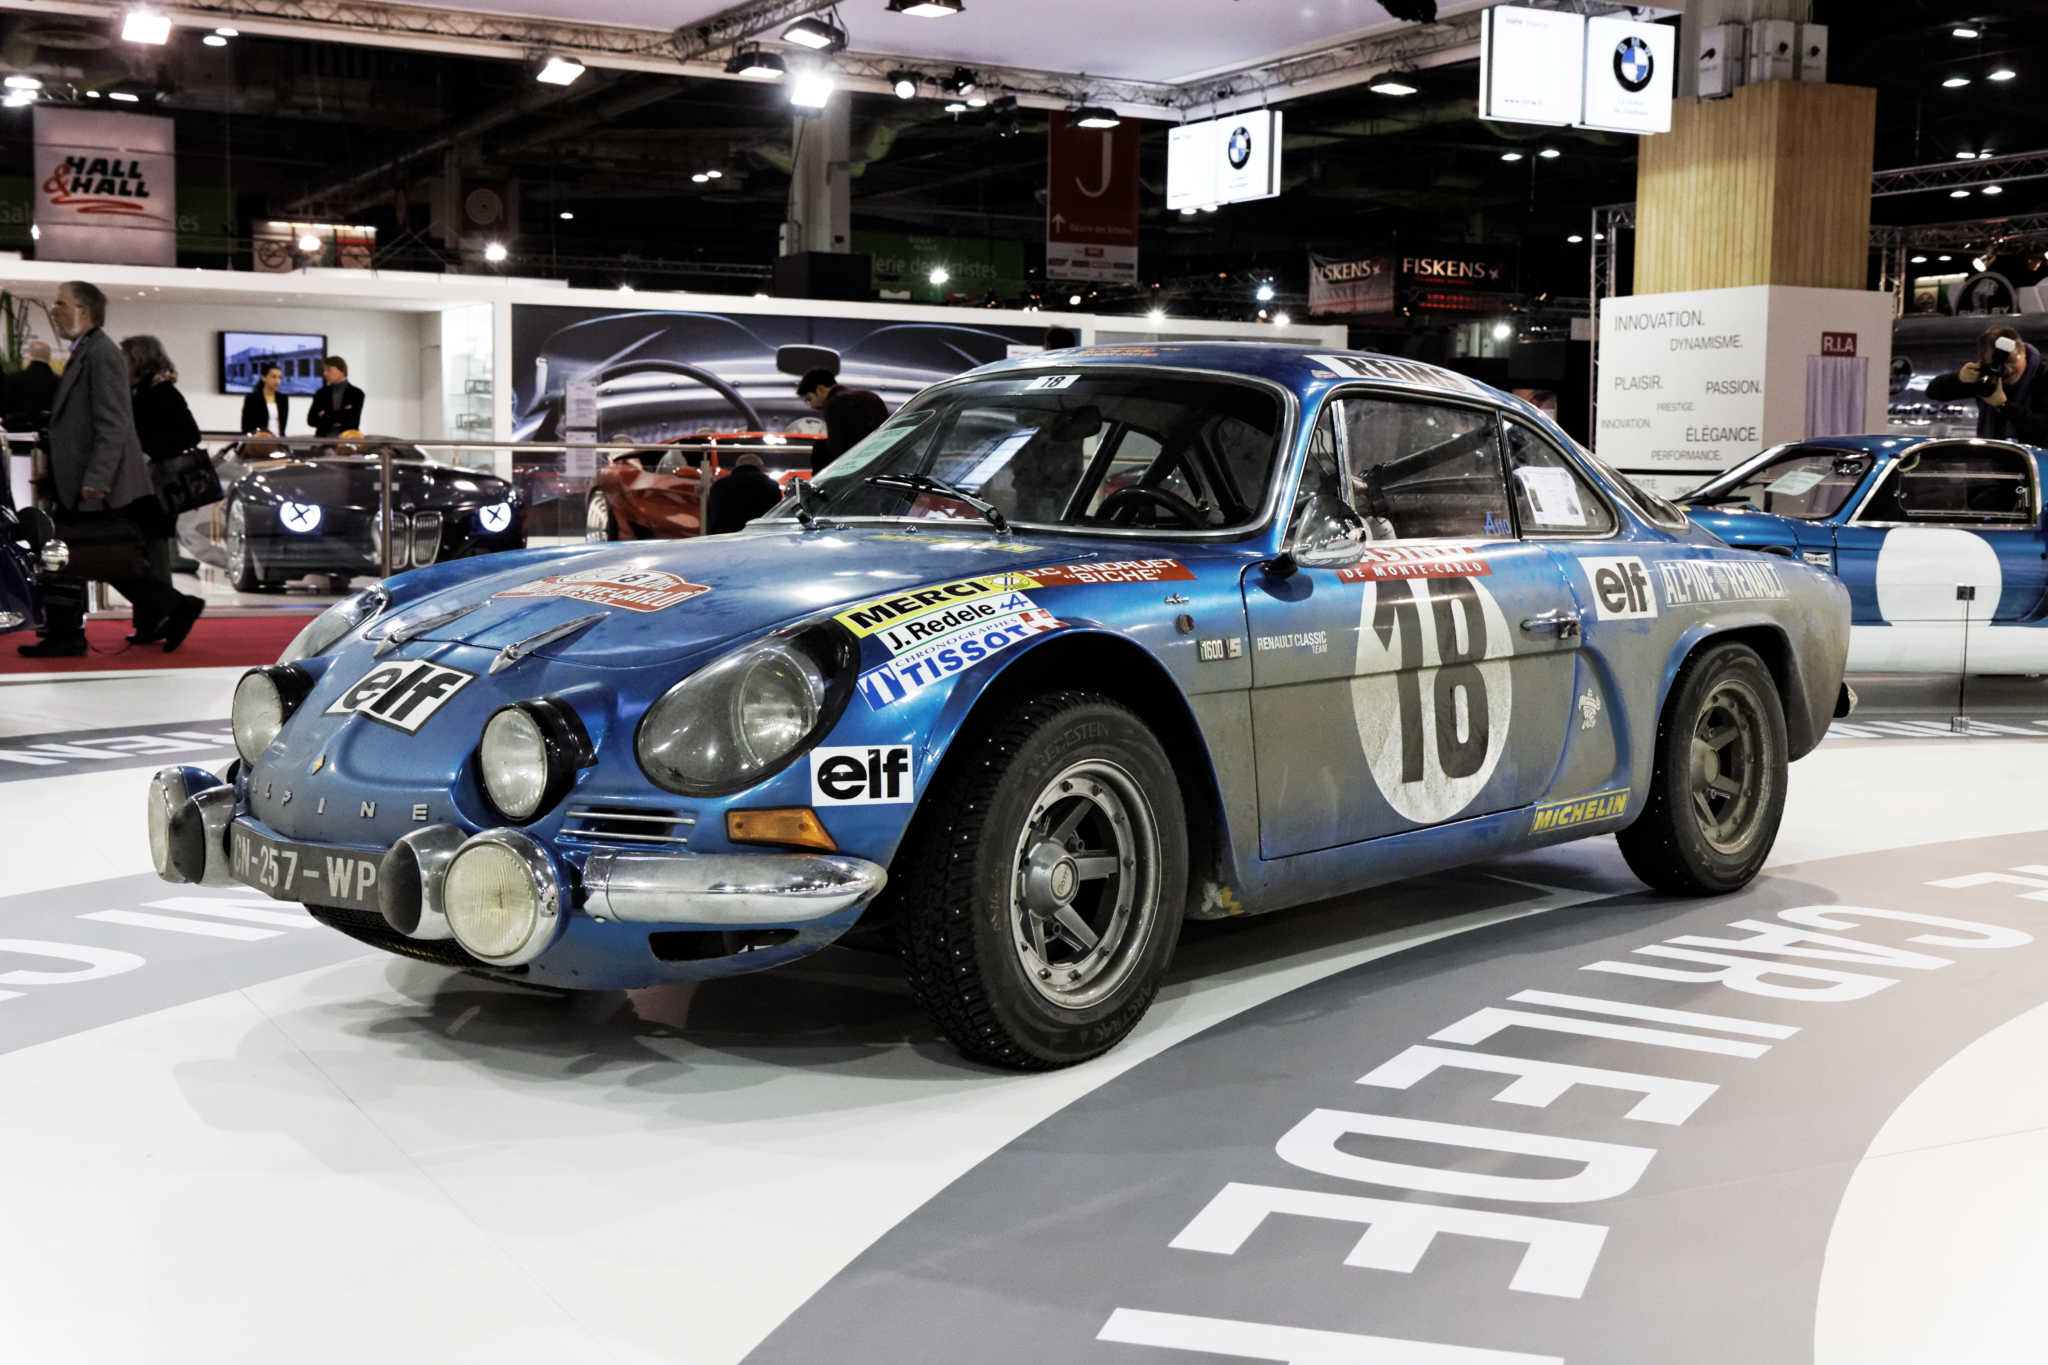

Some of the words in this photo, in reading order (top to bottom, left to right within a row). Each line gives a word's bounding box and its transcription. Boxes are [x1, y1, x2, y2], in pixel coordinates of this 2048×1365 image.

[66, 156, 143, 179] HALL
[1075, 131, 1113, 198] J
[70, 177, 149, 198] HALL
[1402, 258, 1486, 278] FISKENS
[1614, 310, 1705, 331] INNOVATION.
[1670, 335, 1743, 351] DYNAMISME.
[1040, 376, 1066, 388] 18
[1614, 376, 1663, 390] PLAISIR.
[1705, 380, 1762, 394] PASSION.
[1065, 558, 1179, 574] ANDRUET
[1343, 568, 1366, 579] DE
[1373, 561, 1483, 577] MONTE-CARLO
[1595, 562, 1648, 613] elf
[1660, 561, 1721, 604] ALPINE
[1727, 560, 1786, 599] RENAULT
[847, 581, 990, 630] MERCI
[895, 617, 1018, 668] CHRONOGRAPHES
[1200, 640, 1224, 661] 1600
[1257, 634, 1294, 651] RENAULT
[1294, 631, 1327, 647] CLASSIC
[1312, 644, 1329, 656] TEAM
[901, 624, 1030, 687] TISSOT
[1372, 577, 1489, 784] 18
[342, 664, 464, 722] elf
[817, 749, 909, 800] elf
[253, 778, 428, 821] PINE
[1533, 794, 1629, 831] MICHELIN
[1579, 904, 2034, 1002] CAR
